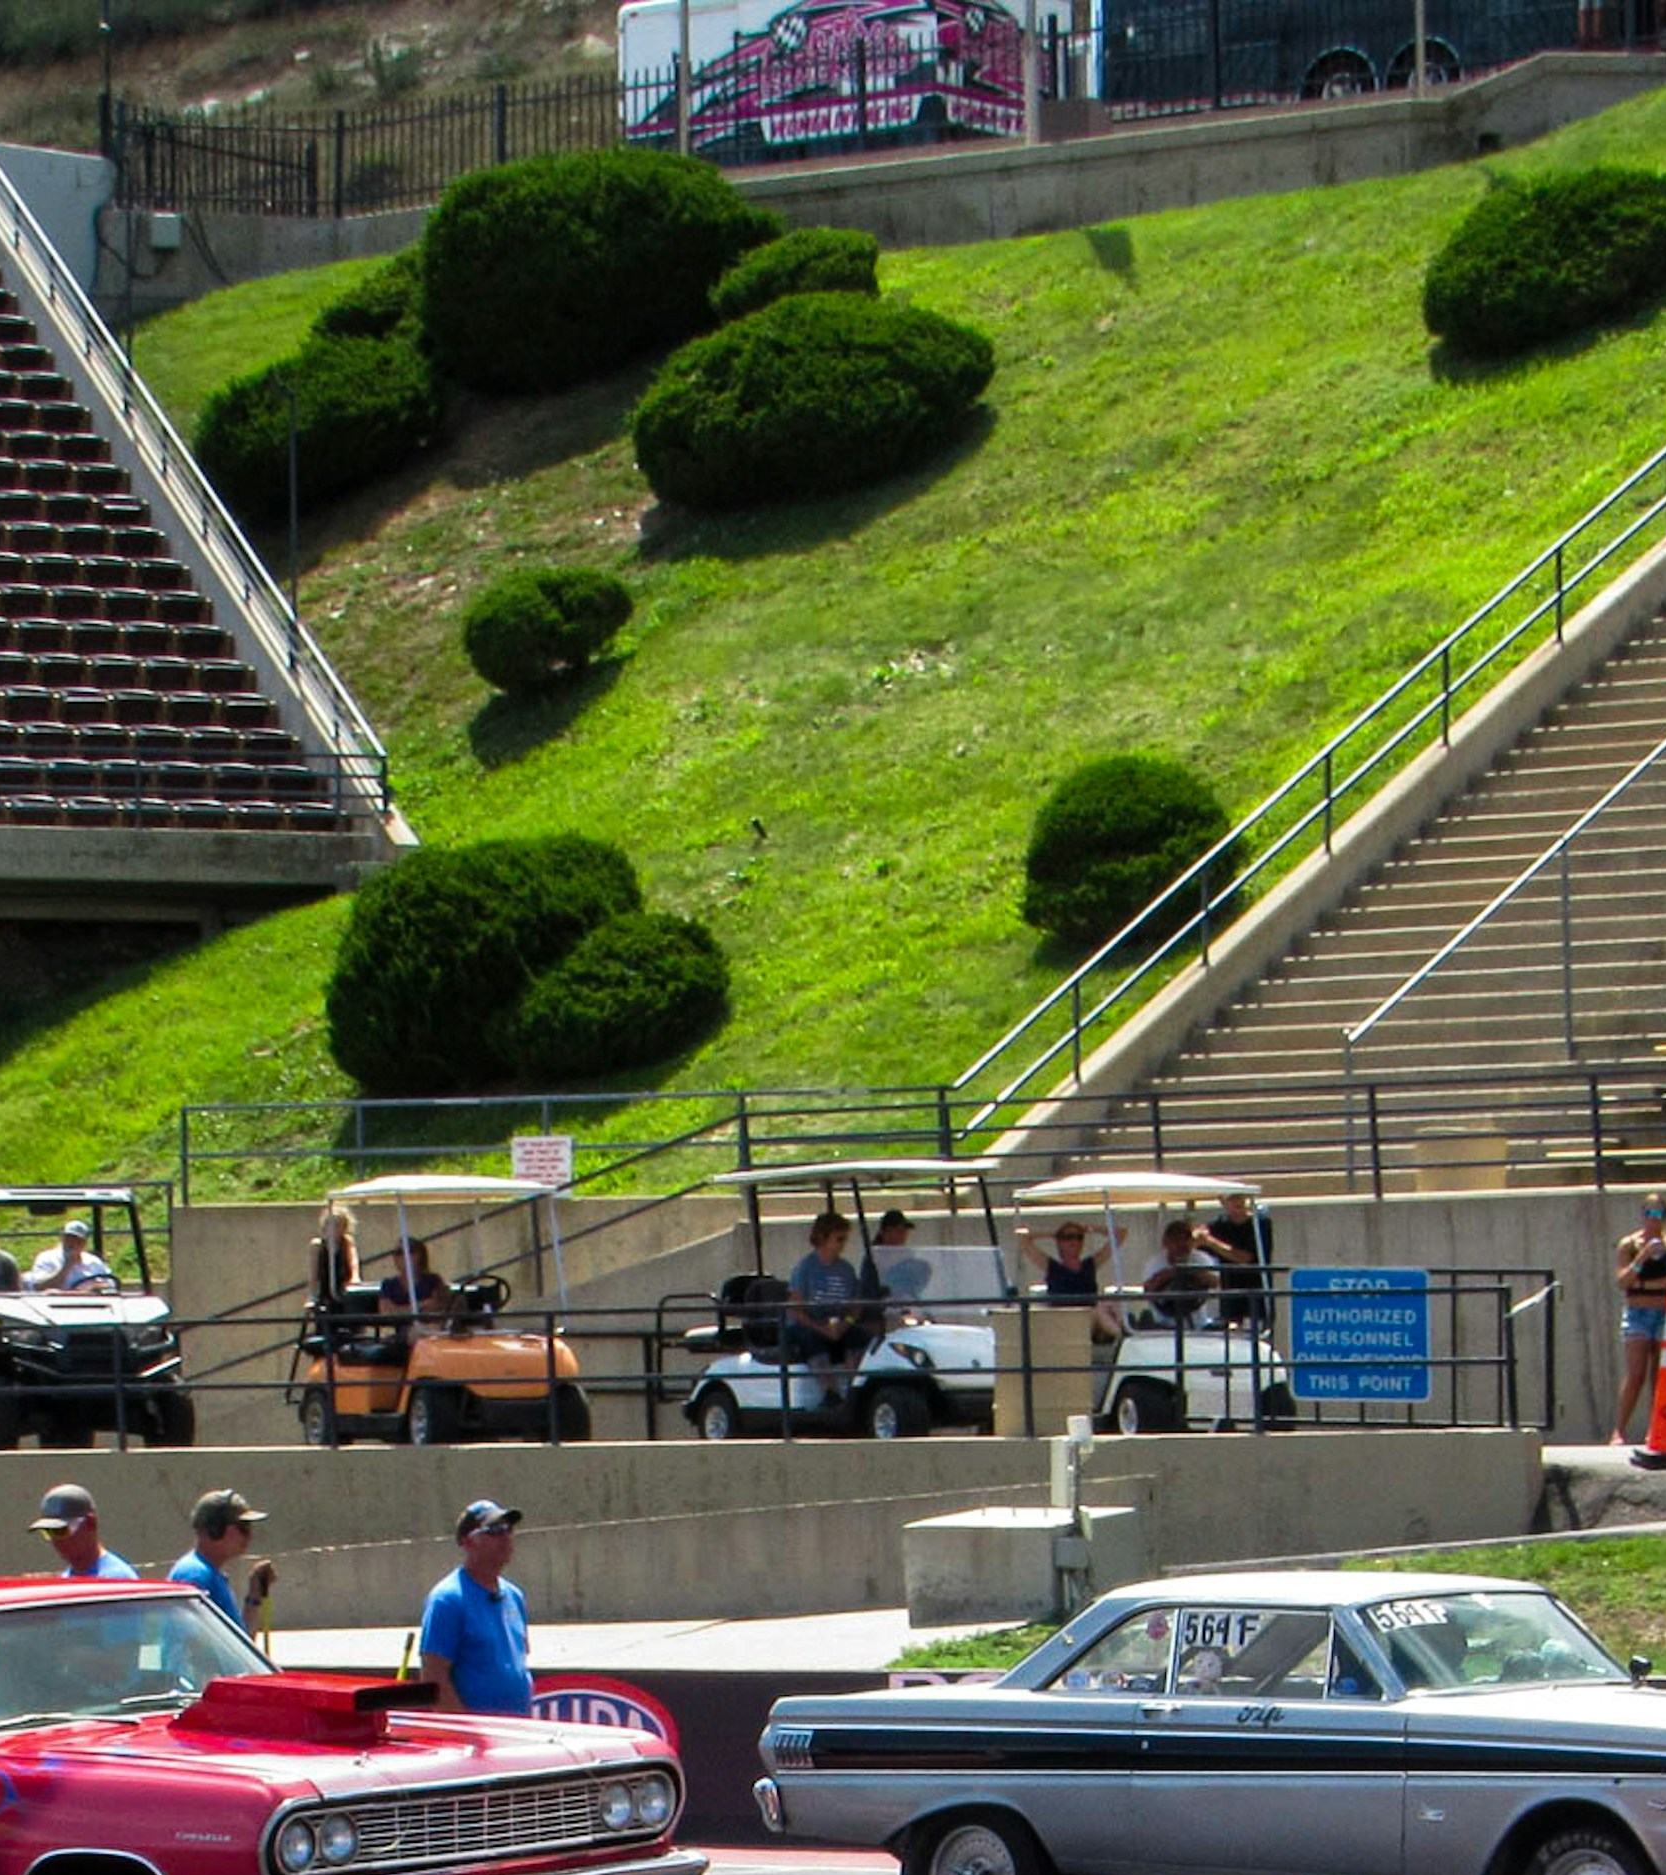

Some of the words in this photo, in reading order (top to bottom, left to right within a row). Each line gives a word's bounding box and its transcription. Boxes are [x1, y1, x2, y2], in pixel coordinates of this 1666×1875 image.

[1302, 1307, 1417, 1325] AUTHORIZED
[1304, 1330, 1413, 1347] PERSONNEL
[1309, 1374, 1349, 1391] THIS
[1359, 1374, 1411, 1391] POINT
